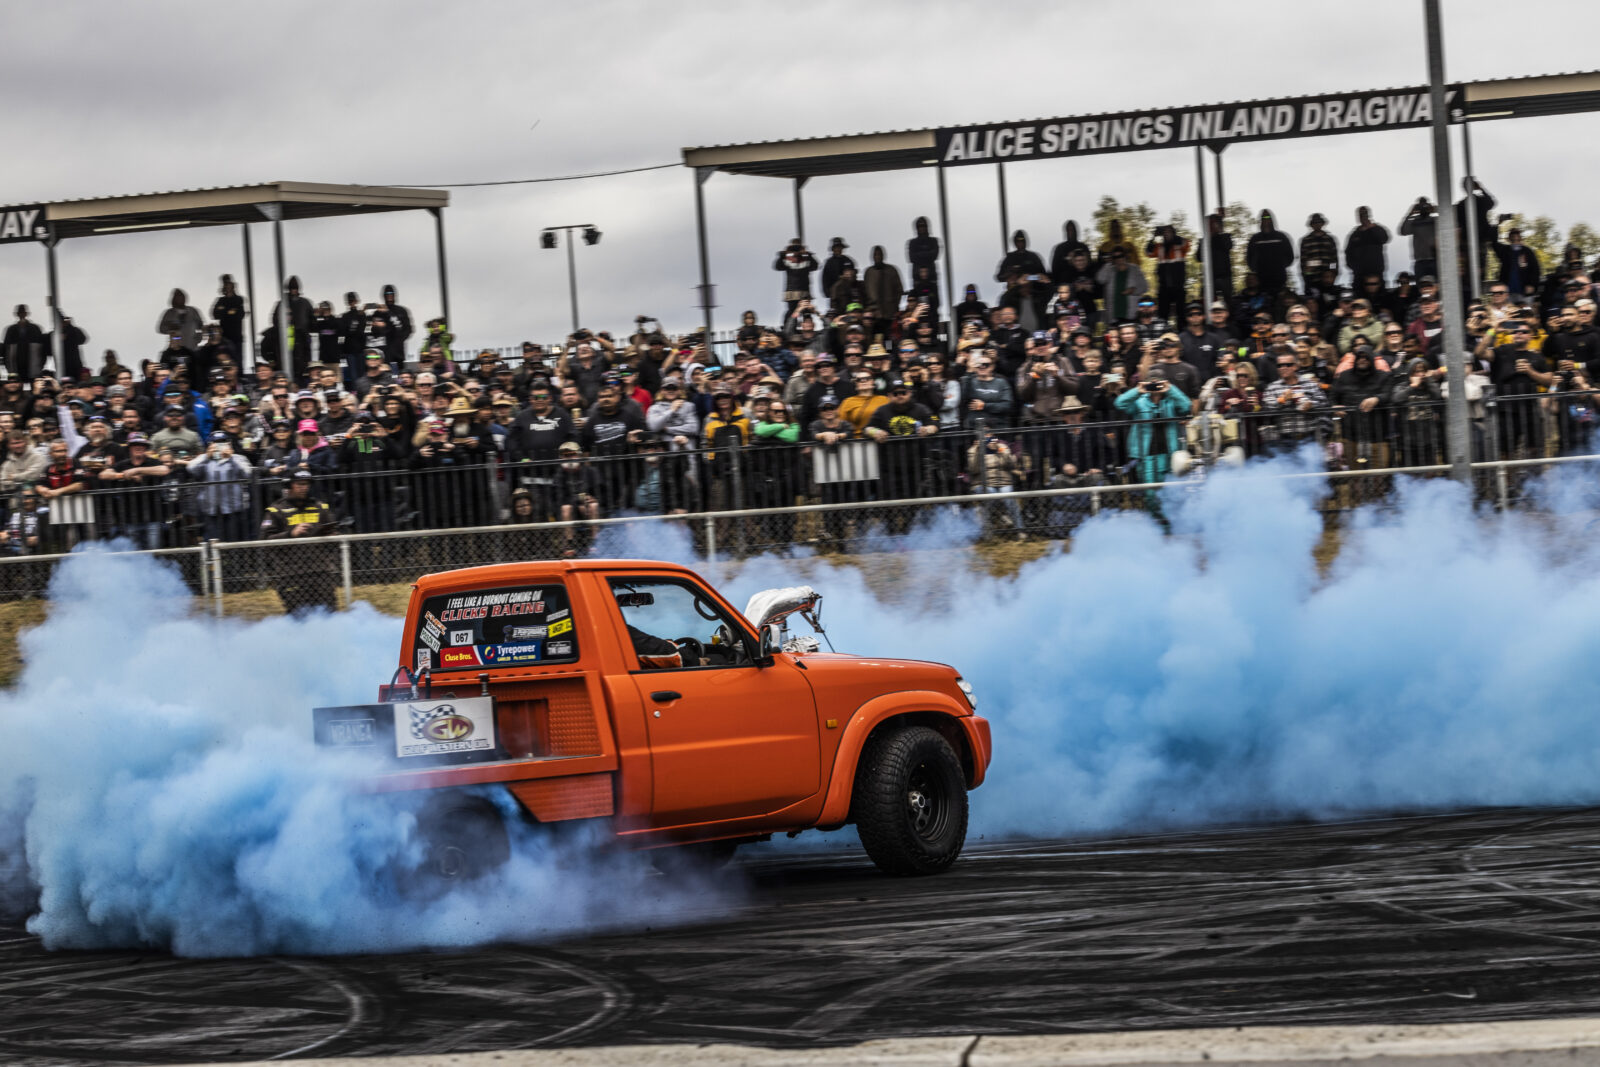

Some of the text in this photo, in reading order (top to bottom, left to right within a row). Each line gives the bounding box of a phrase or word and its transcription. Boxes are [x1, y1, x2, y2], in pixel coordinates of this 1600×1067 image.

[943, 126, 1036, 161] ALICE
[1040, 114, 1174, 153] SPRINGS
[1178, 104, 1296, 142] INLAND
[447, 590, 543, 609] I FEEL LIKE A BURNOUT COMING ON
[441, 606, 489, 621] CLICKS
[491, 601, 545, 617] RACING
[455, 633, 469, 643] 067
[497, 645, 536, 656] Tyrepower
